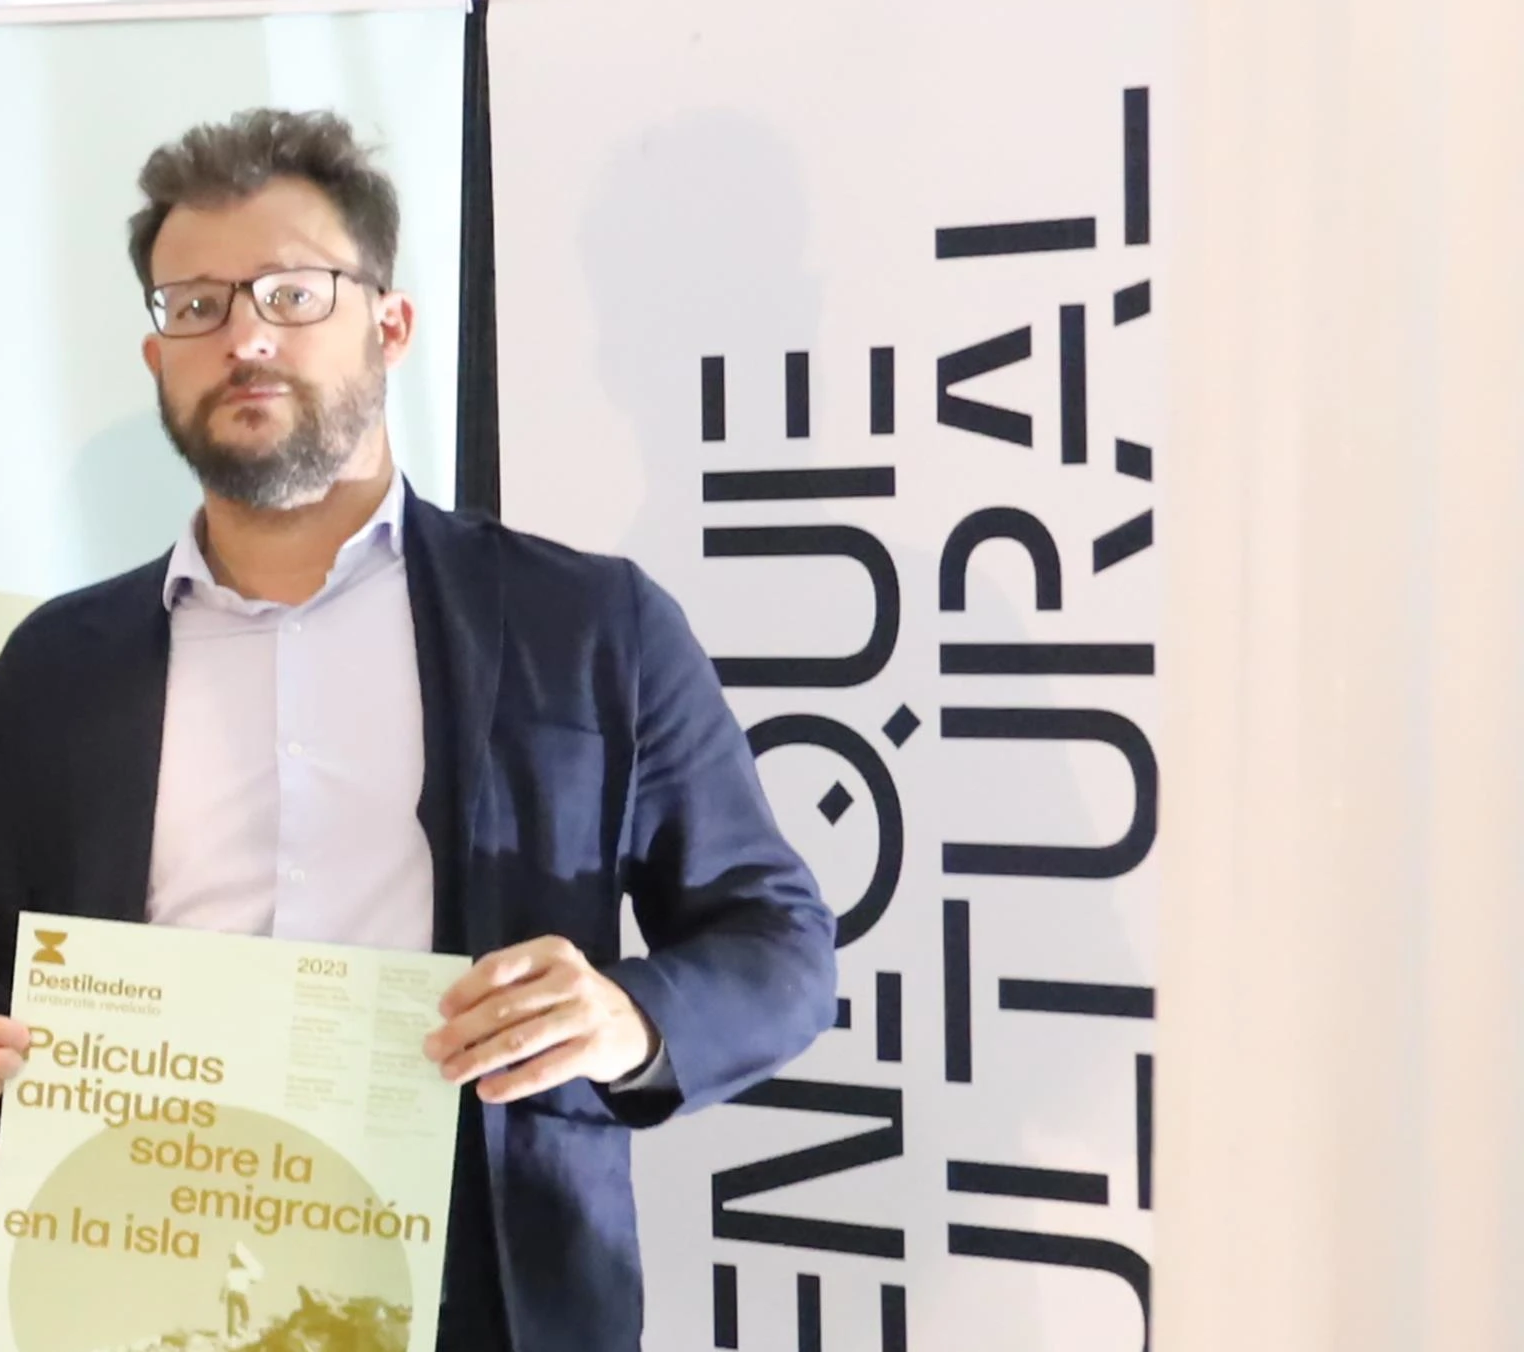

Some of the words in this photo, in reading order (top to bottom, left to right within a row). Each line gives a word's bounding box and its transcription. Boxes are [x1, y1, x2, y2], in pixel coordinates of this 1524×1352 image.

[28, 967, 163, 1002] Destiladera
[296, 956, 348, 978] 2023
[23, 1026, 225, 1085] Películas
[16, 1078, 217, 1129] antiguas
[129, 1132, 260, 1177] sobre
[272, 1142, 314, 1185] la
[3, 1208, 58, 1242] en
[71, 1206, 111, 1250] la
[124, 1212, 201, 1259] isla
[170, 1183, 431, 1243] emigración
